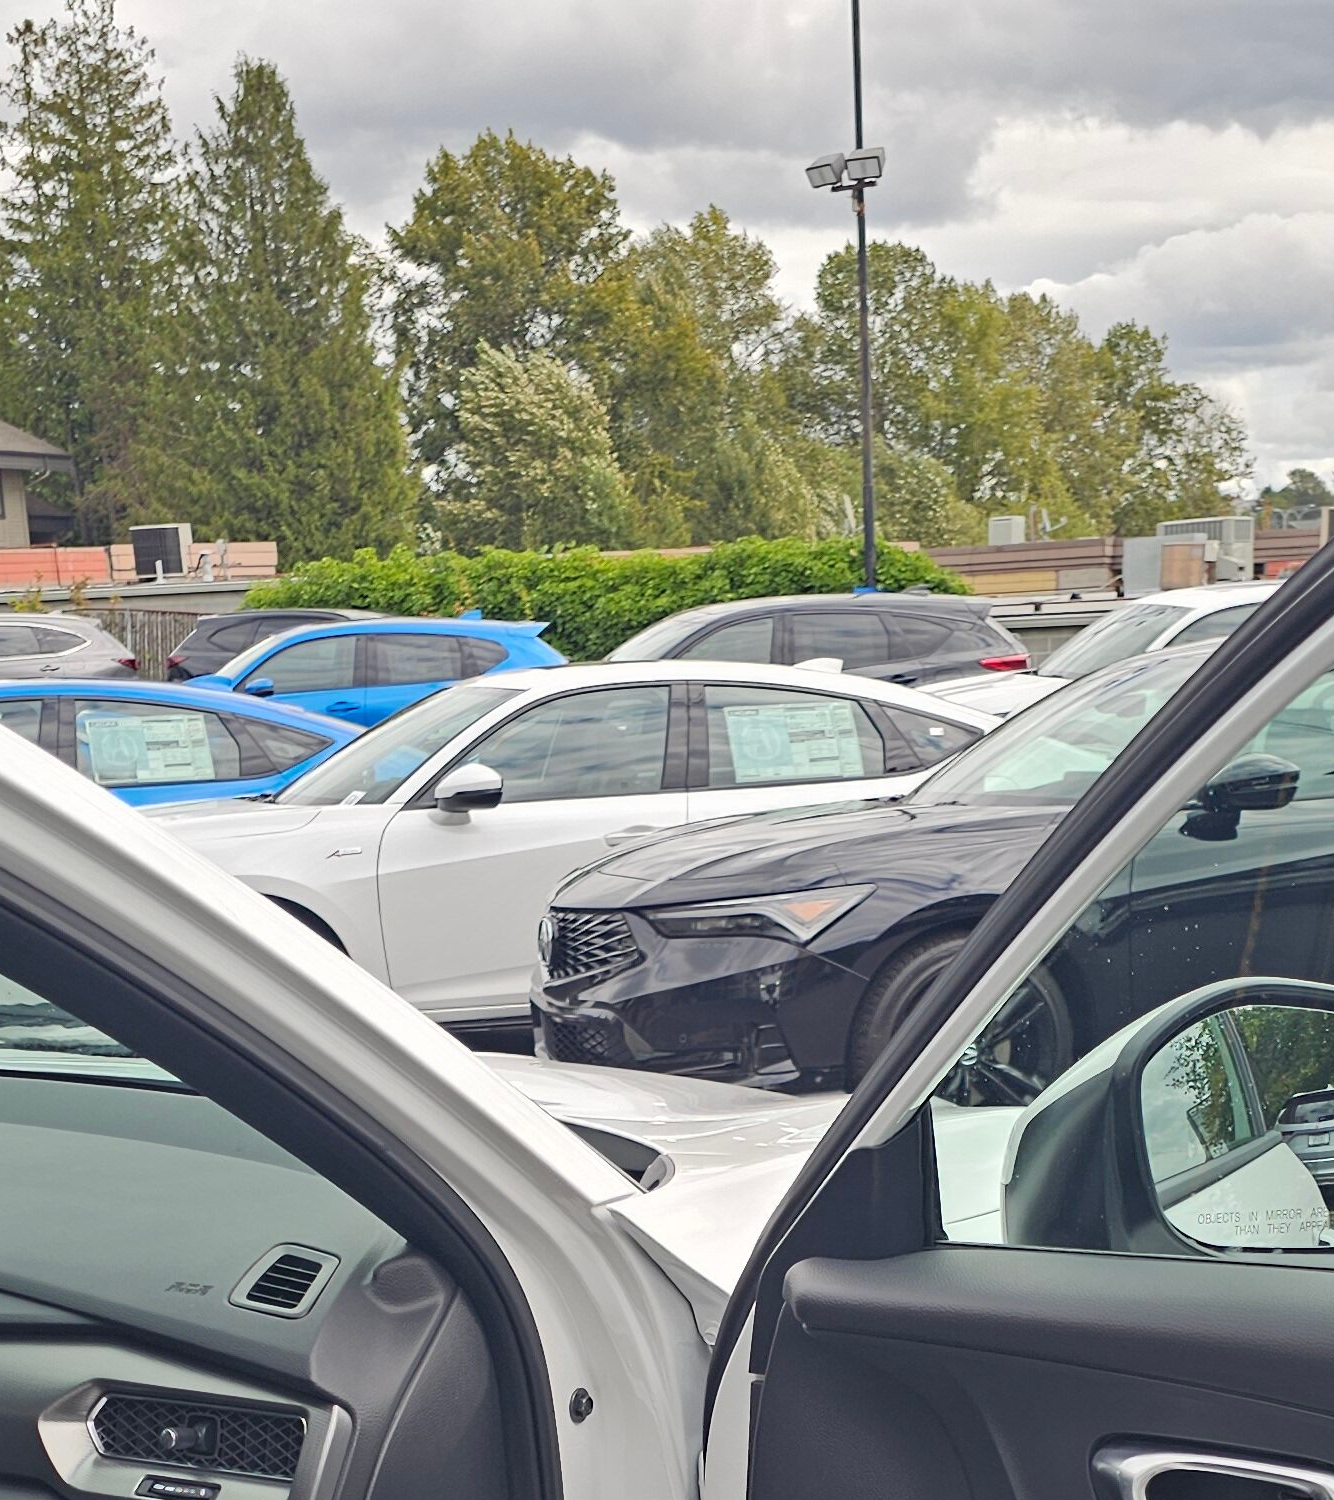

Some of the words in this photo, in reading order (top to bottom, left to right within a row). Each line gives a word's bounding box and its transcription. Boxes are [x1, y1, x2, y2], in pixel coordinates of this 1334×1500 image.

[1197, 1212, 1241, 1225] OBJECTS
[1248, 1211, 1258, 1222] IN
[1265, 1208, 1302, 1222] MIRROR
[1310, 1206, 1329, 1218] ARE
[1234, 1223, 1260, 1236] THAN
[1267, 1221, 1292, 1235] THEY
